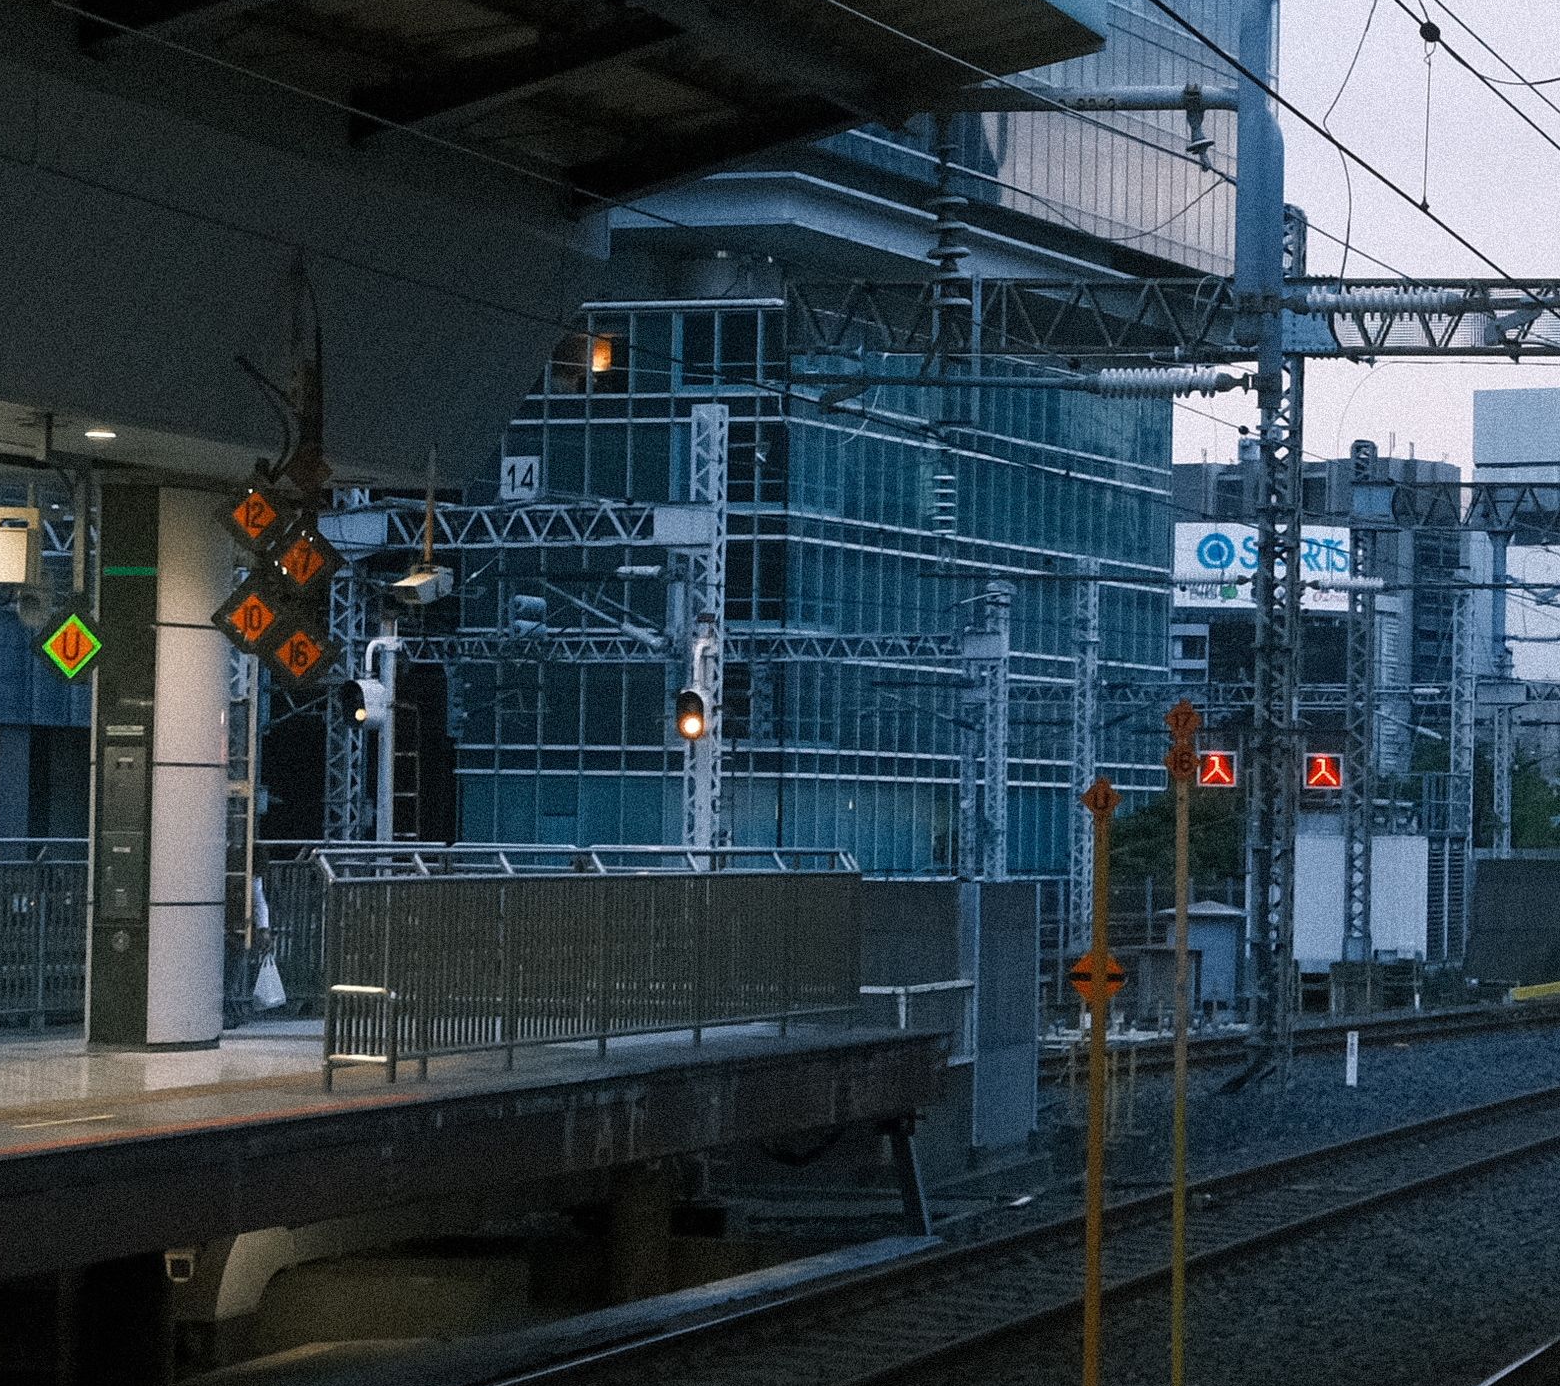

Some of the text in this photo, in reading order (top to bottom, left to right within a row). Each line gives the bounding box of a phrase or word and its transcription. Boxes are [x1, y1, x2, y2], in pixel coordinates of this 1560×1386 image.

[507, 464, 533, 492] 14
[245, 500, 266, 529] 12
[243, 604, 263, 632] 10
[62, 630, 80, 661] U
[289, 640, 309, 667] 16
